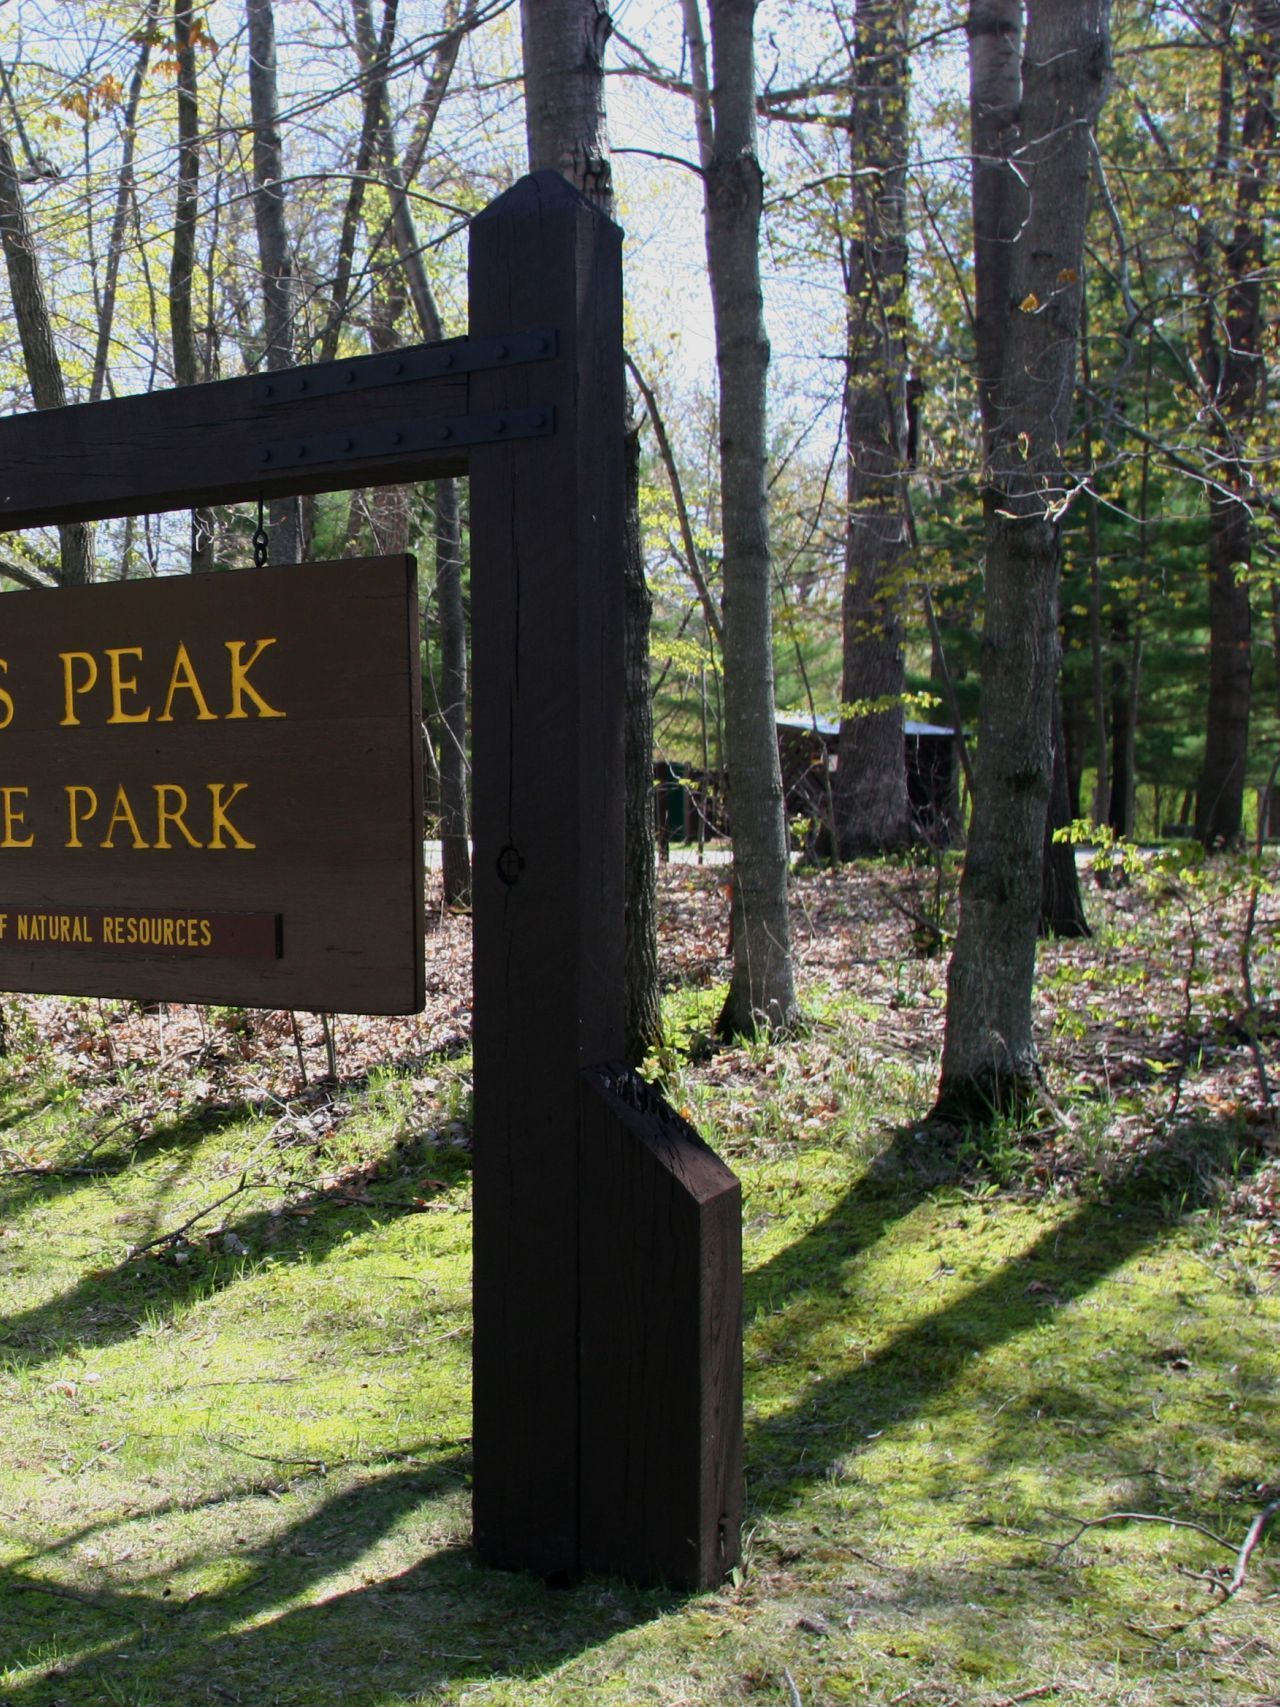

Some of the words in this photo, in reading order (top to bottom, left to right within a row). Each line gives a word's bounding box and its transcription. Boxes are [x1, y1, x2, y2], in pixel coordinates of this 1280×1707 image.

[59, 637, 287, 726] PEAK
[64, 782, 257, 850] PARK
[17, 914, 93, 943] NATURAL
[103, 917, 213, 947] RESOURCES
